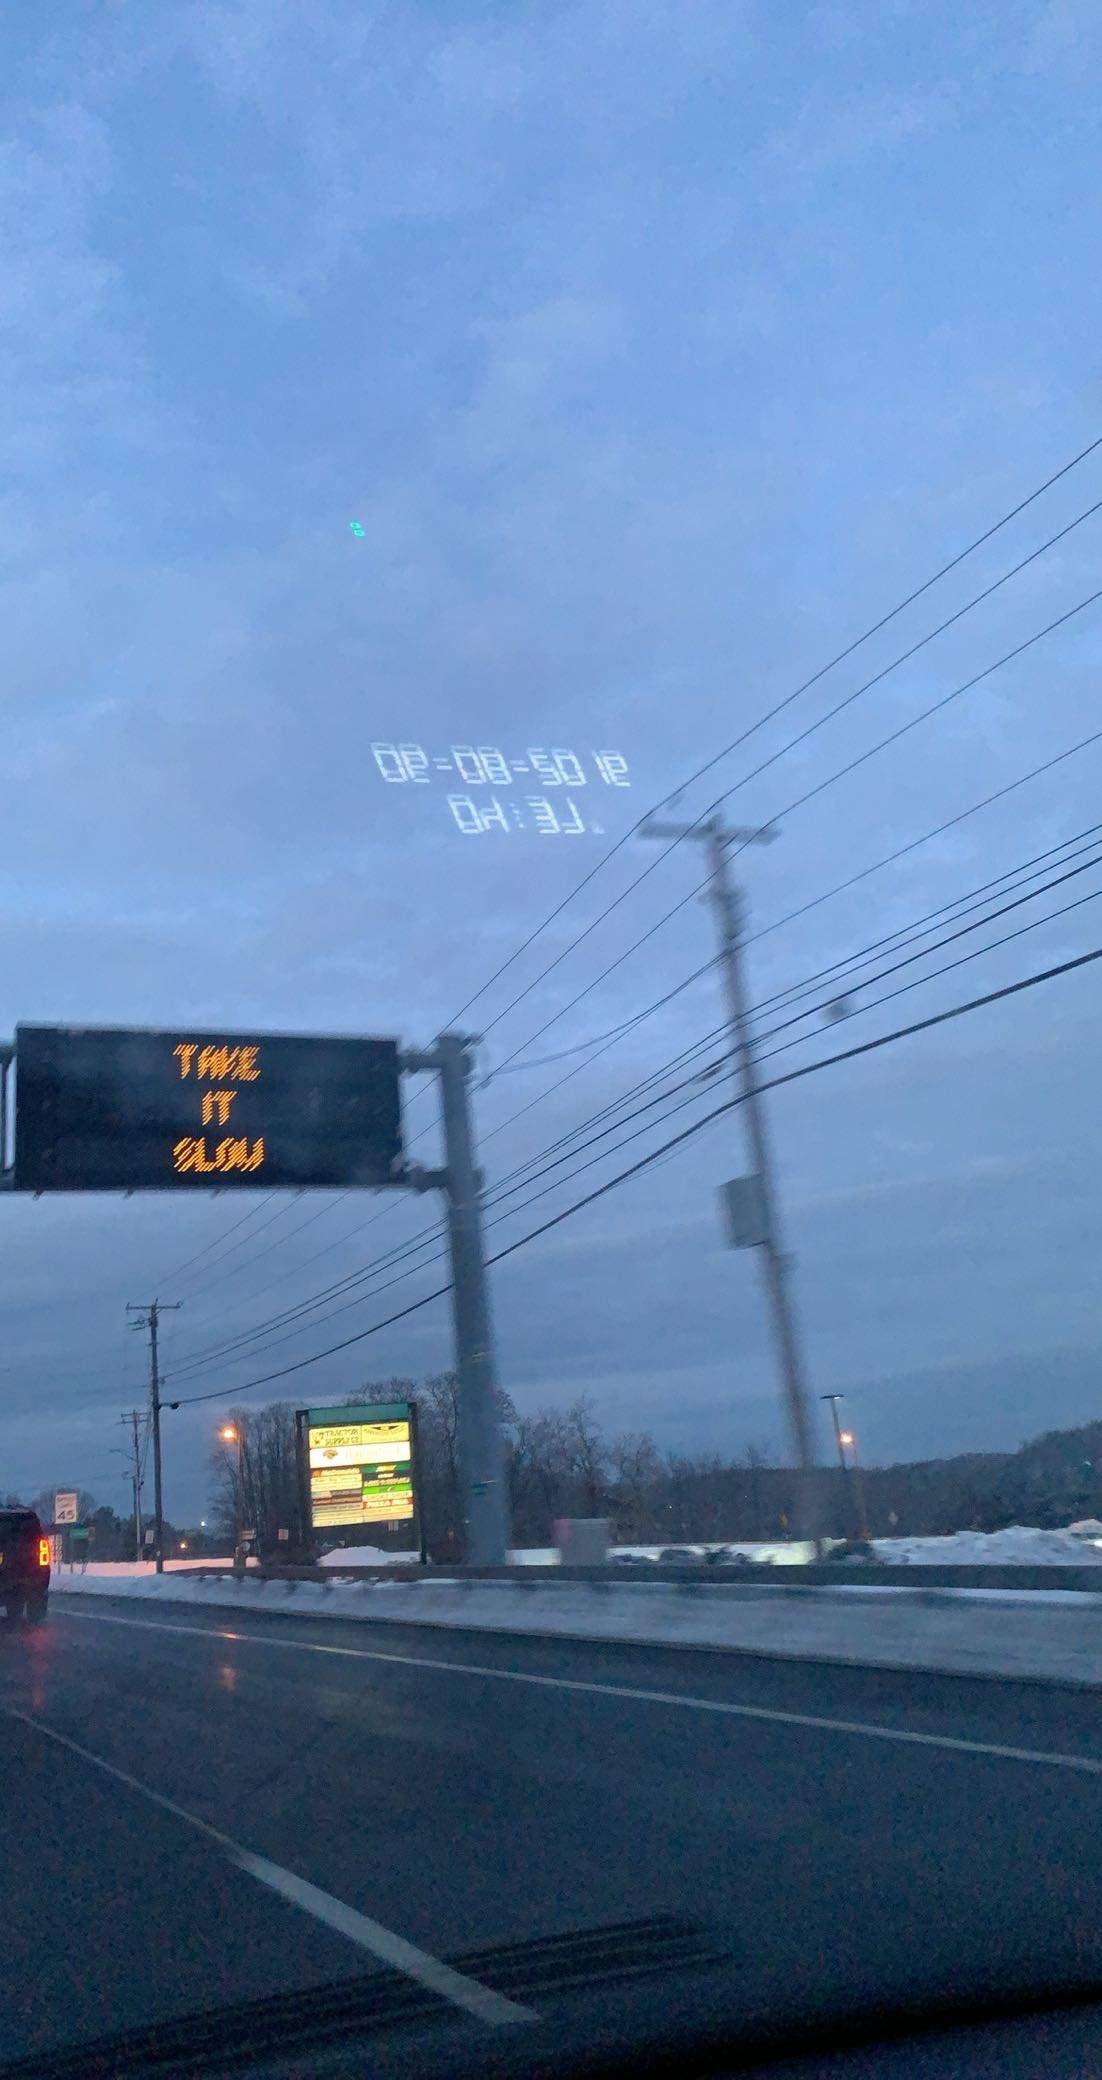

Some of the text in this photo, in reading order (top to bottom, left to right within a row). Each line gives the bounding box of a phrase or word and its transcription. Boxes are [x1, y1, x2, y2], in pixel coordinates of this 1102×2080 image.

[172, 1044, 261, 1081] TAKE
[202, 1091, 237, 1126] IT
[172, 1137, 264, 1172] SLOW
[57, 1510, 75, 1520] 45
